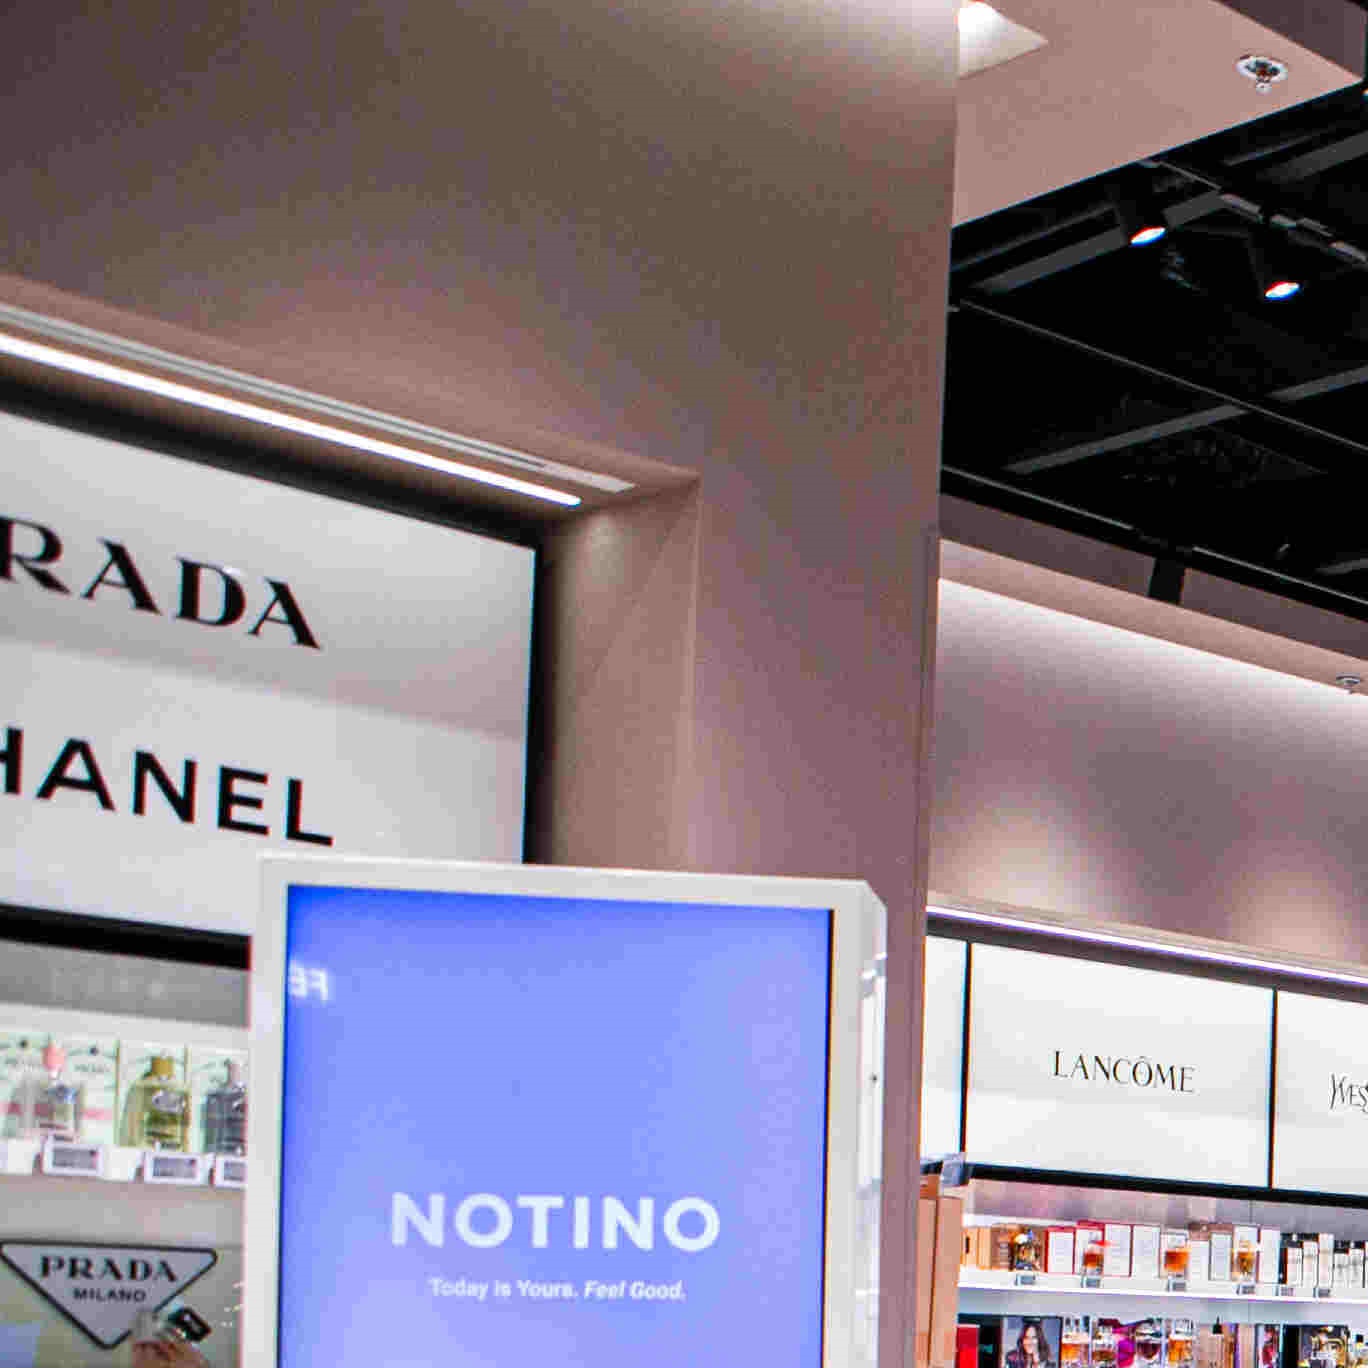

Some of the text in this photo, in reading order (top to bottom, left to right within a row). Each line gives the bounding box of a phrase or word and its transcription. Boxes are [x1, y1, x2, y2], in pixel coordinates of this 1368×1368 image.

[0, 514, 323, 651] RADA
[0, 724, 334, 847] ANEL
[1053, 1049, 1197, 1094] LANCÔME
[391, 1192, 721, 1252] NOTINO
[40, 1254, 177, 1283] PRADA
[430, 1276, 488, 1301] Today
[515, 1279, 578, 1299] Yours.
[584, 1280, 625, 1299] Feel
[630, 1280, 687, 1301] Good.
[73, 1287, 147, 1302] MILANO
